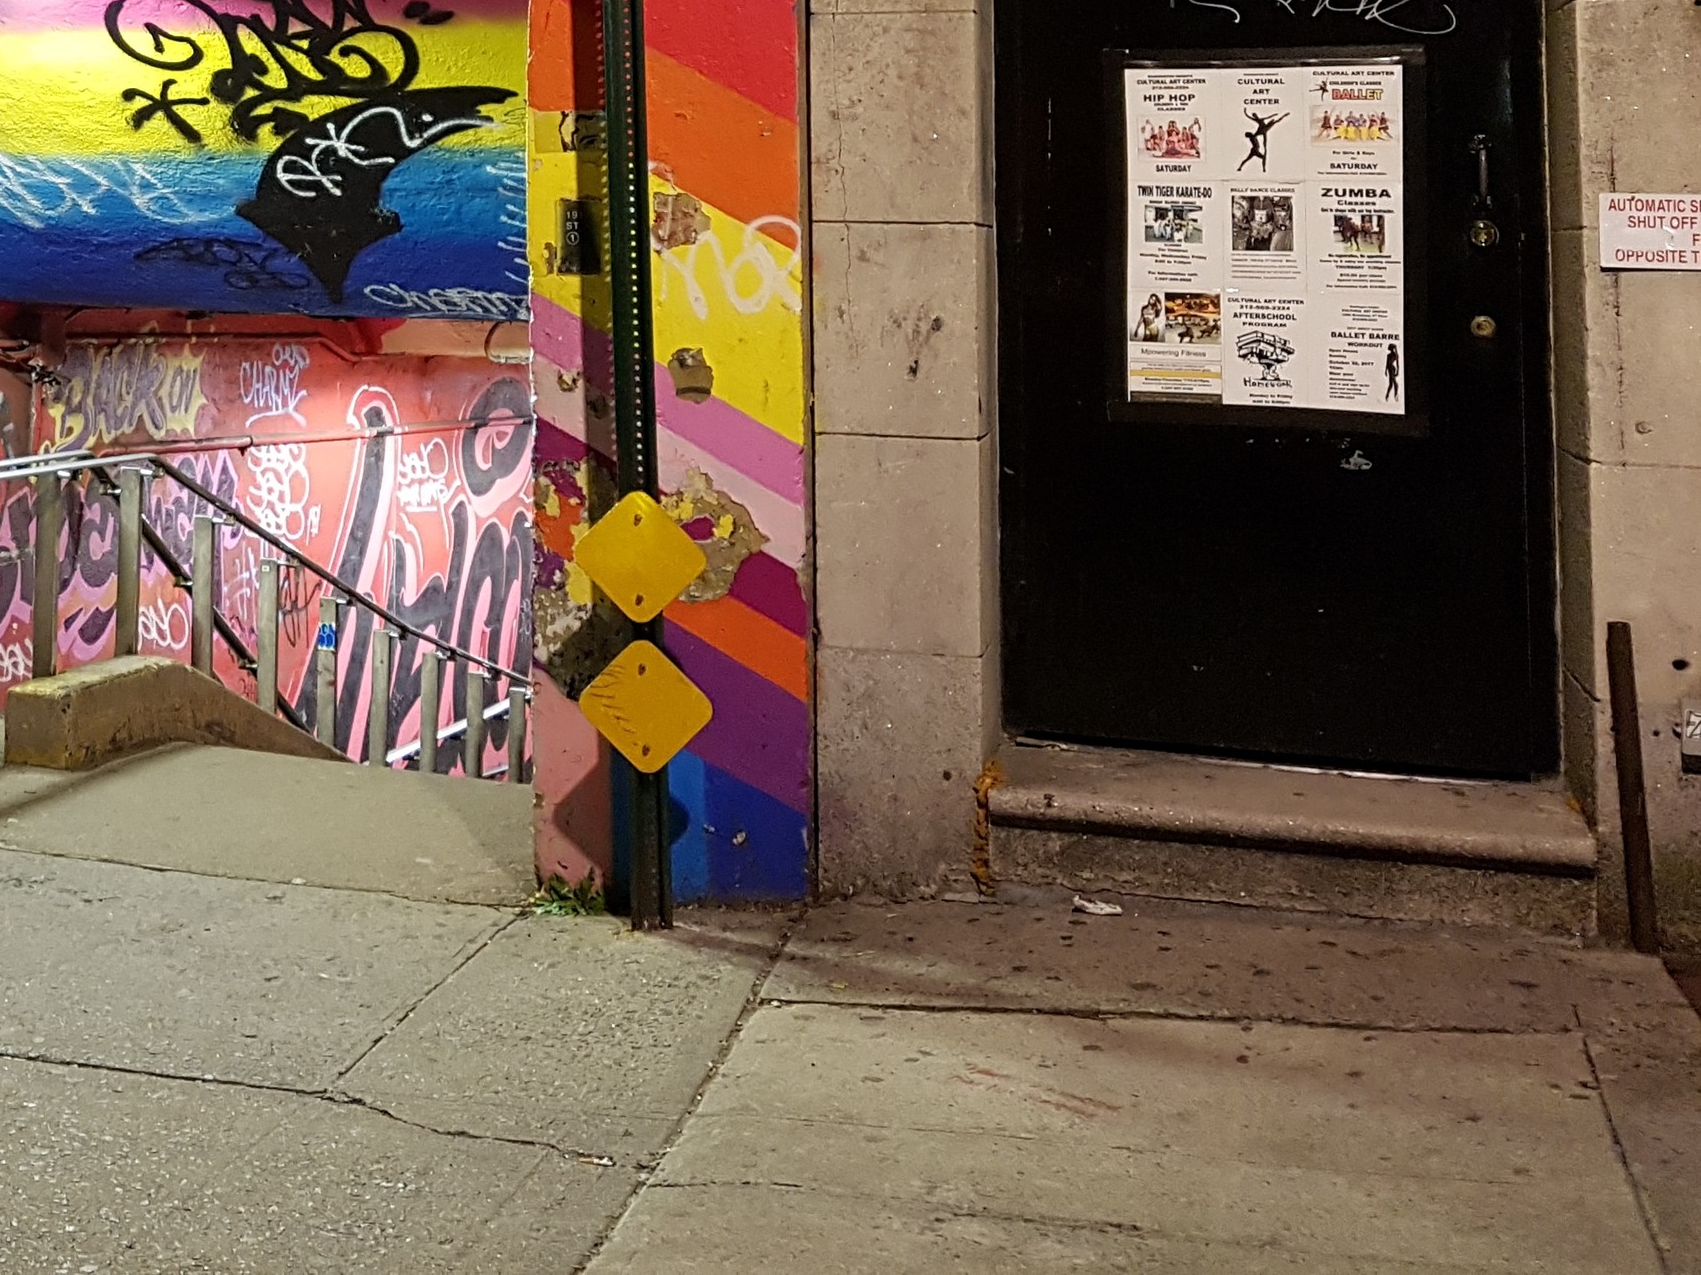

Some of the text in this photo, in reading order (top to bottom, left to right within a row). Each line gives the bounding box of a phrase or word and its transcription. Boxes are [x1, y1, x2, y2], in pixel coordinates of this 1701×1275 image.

[1143, 94, 1195, 102] HIP HOP
[1332, 89, 1383, 100] BALLET
[1137, 185, 1212, 198] TWIN TIGER KARATE-DO
[1321, 188, 1392, 198] ZUMBA
[1608, 199, 1686, 212] AUTOMATIC
[1628, 216, 1698, 229] SHUT OFF
[1615, 249, 1688, 263] OPPOSITE
[1233, 312, 1297, 321] AFTERSCHOOL
[1331, 331, 1366, 339] BALLET
